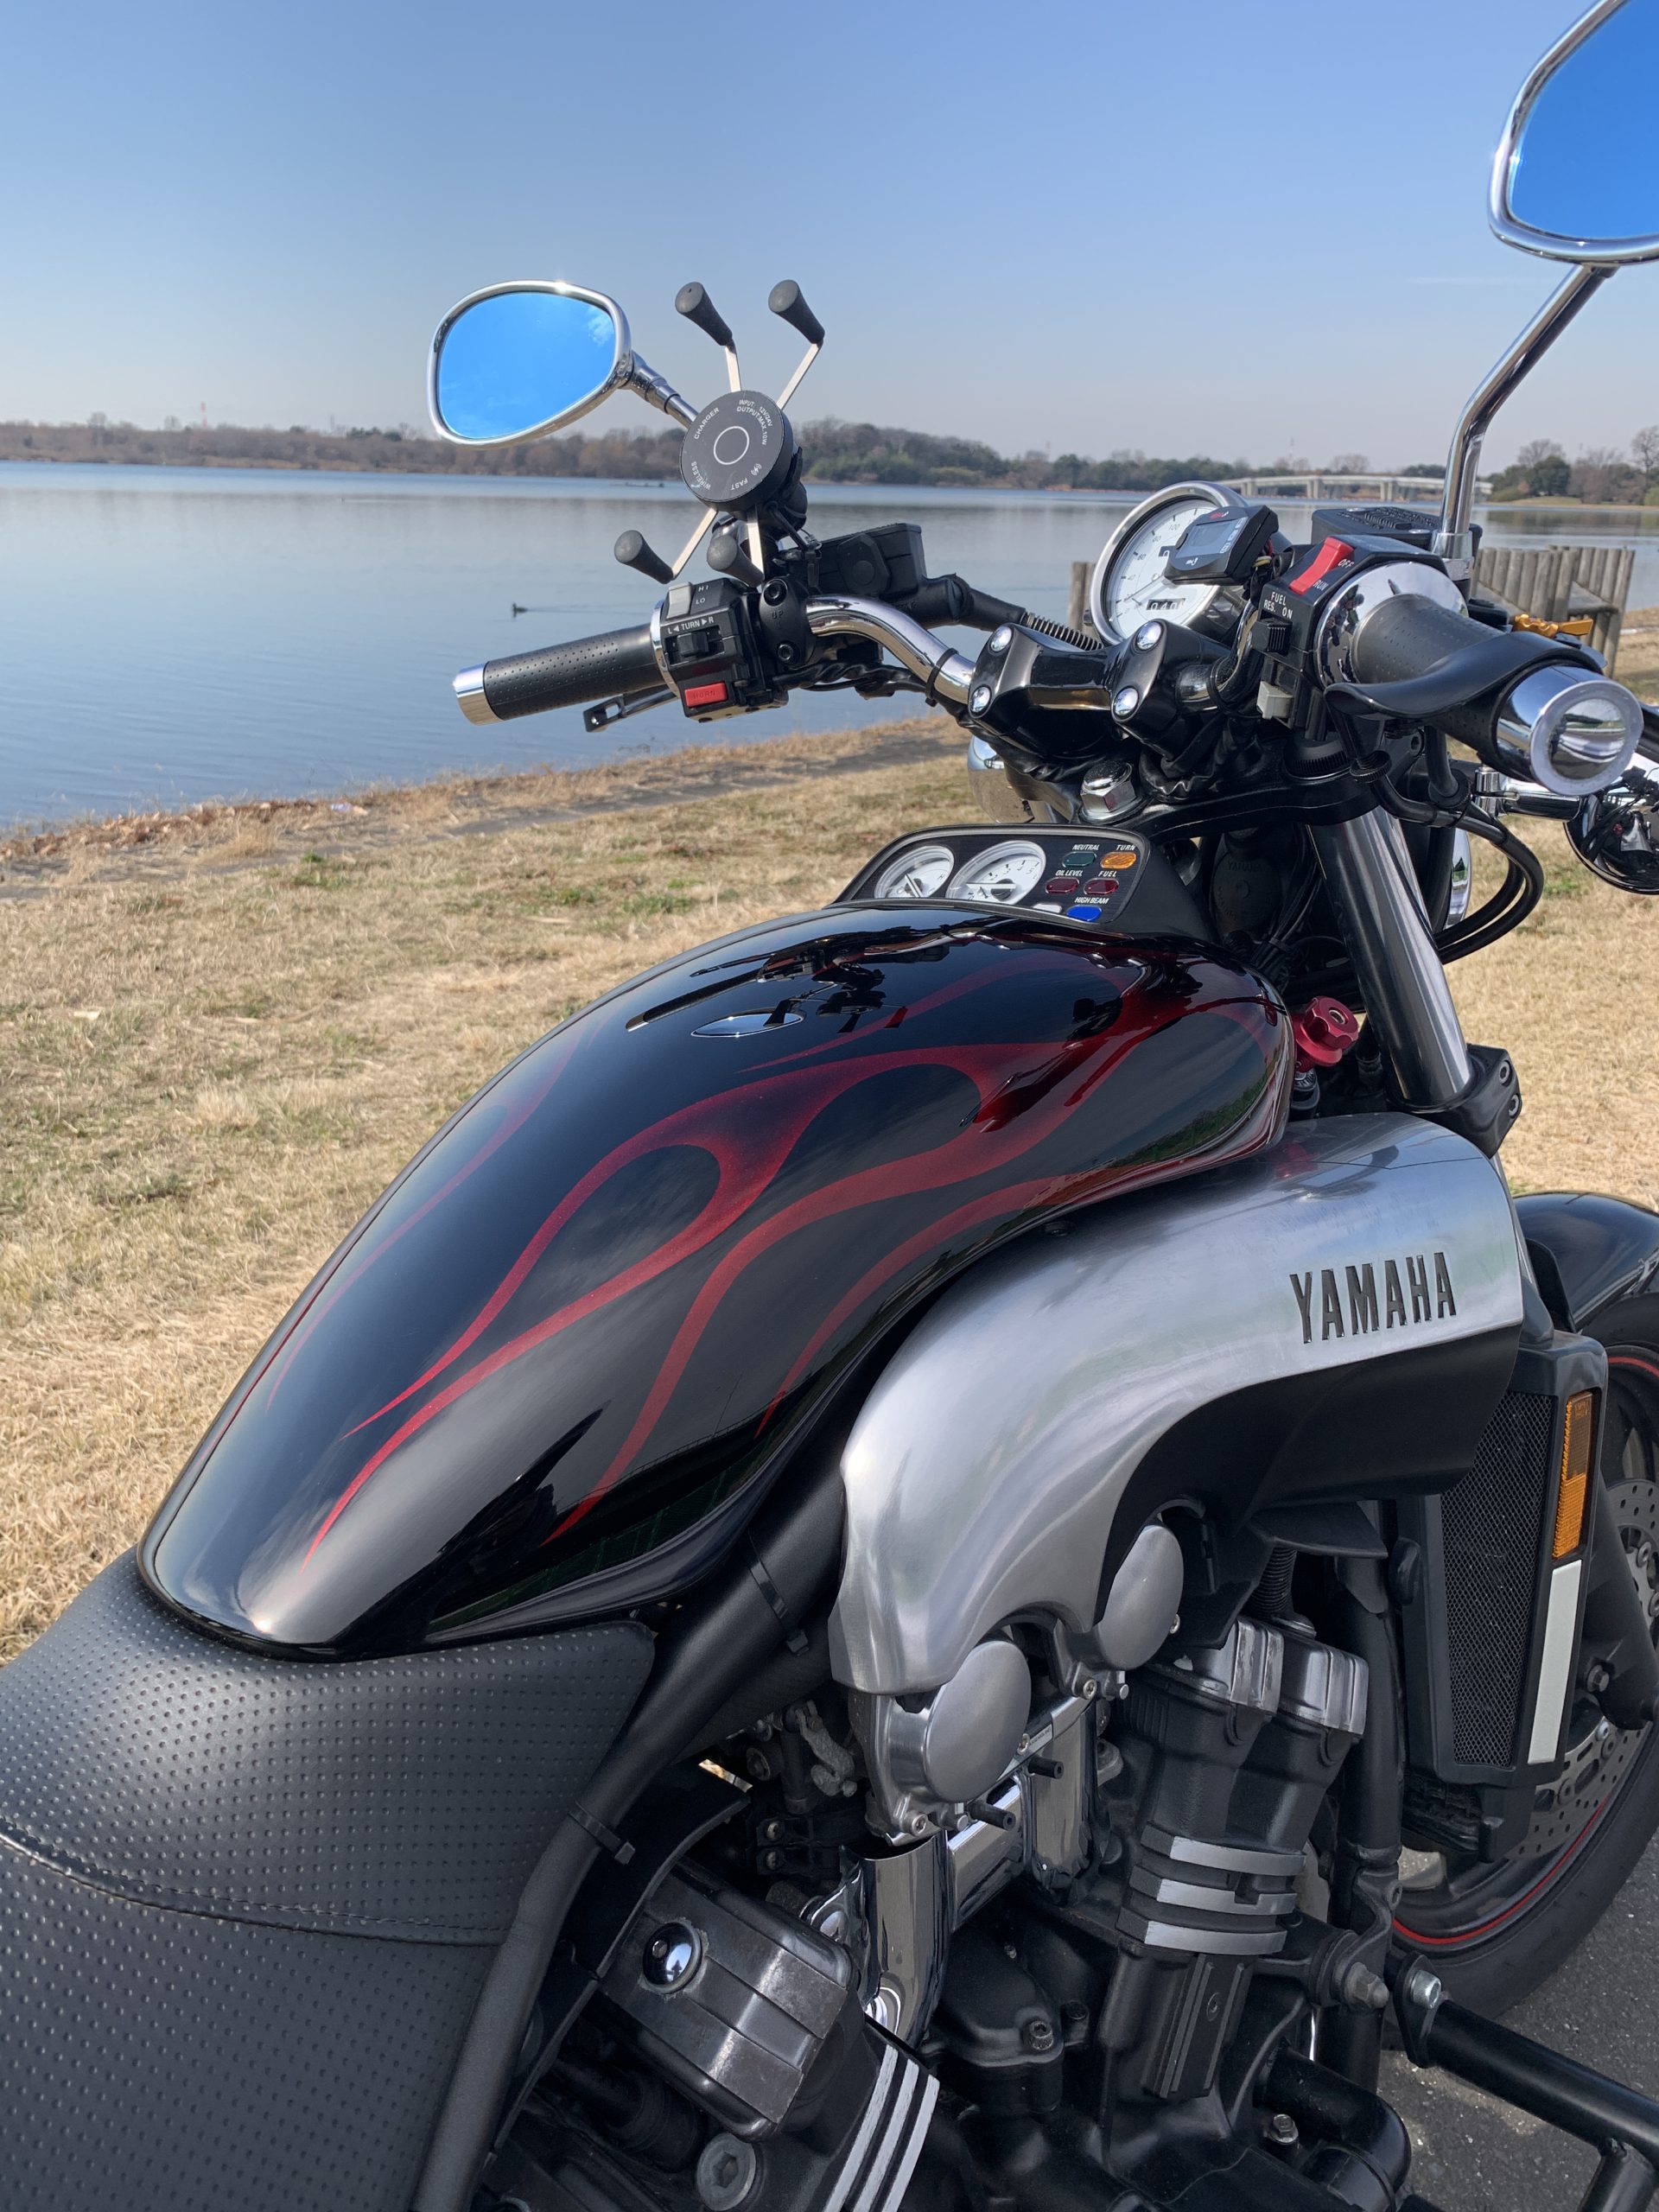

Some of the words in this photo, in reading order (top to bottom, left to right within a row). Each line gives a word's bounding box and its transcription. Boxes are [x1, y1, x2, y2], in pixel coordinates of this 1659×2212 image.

[694, 407, 720, 440] CHARGER
[690, 461, 711, 491] WIRELESS
[730, 477, 748, 491] FAST
[1338, 559, 1354, 568] OFF
[1313, 580, 1328, 590] RUN
[1271, 592, 1286, 606] FUEL
[1263, 600, 1275, 612] RES.
[1282, 607, 1293, 619] ON
[681, 619, 701, 631] TURN
[1288, 1251, 1458, 1344] YAMAHA
